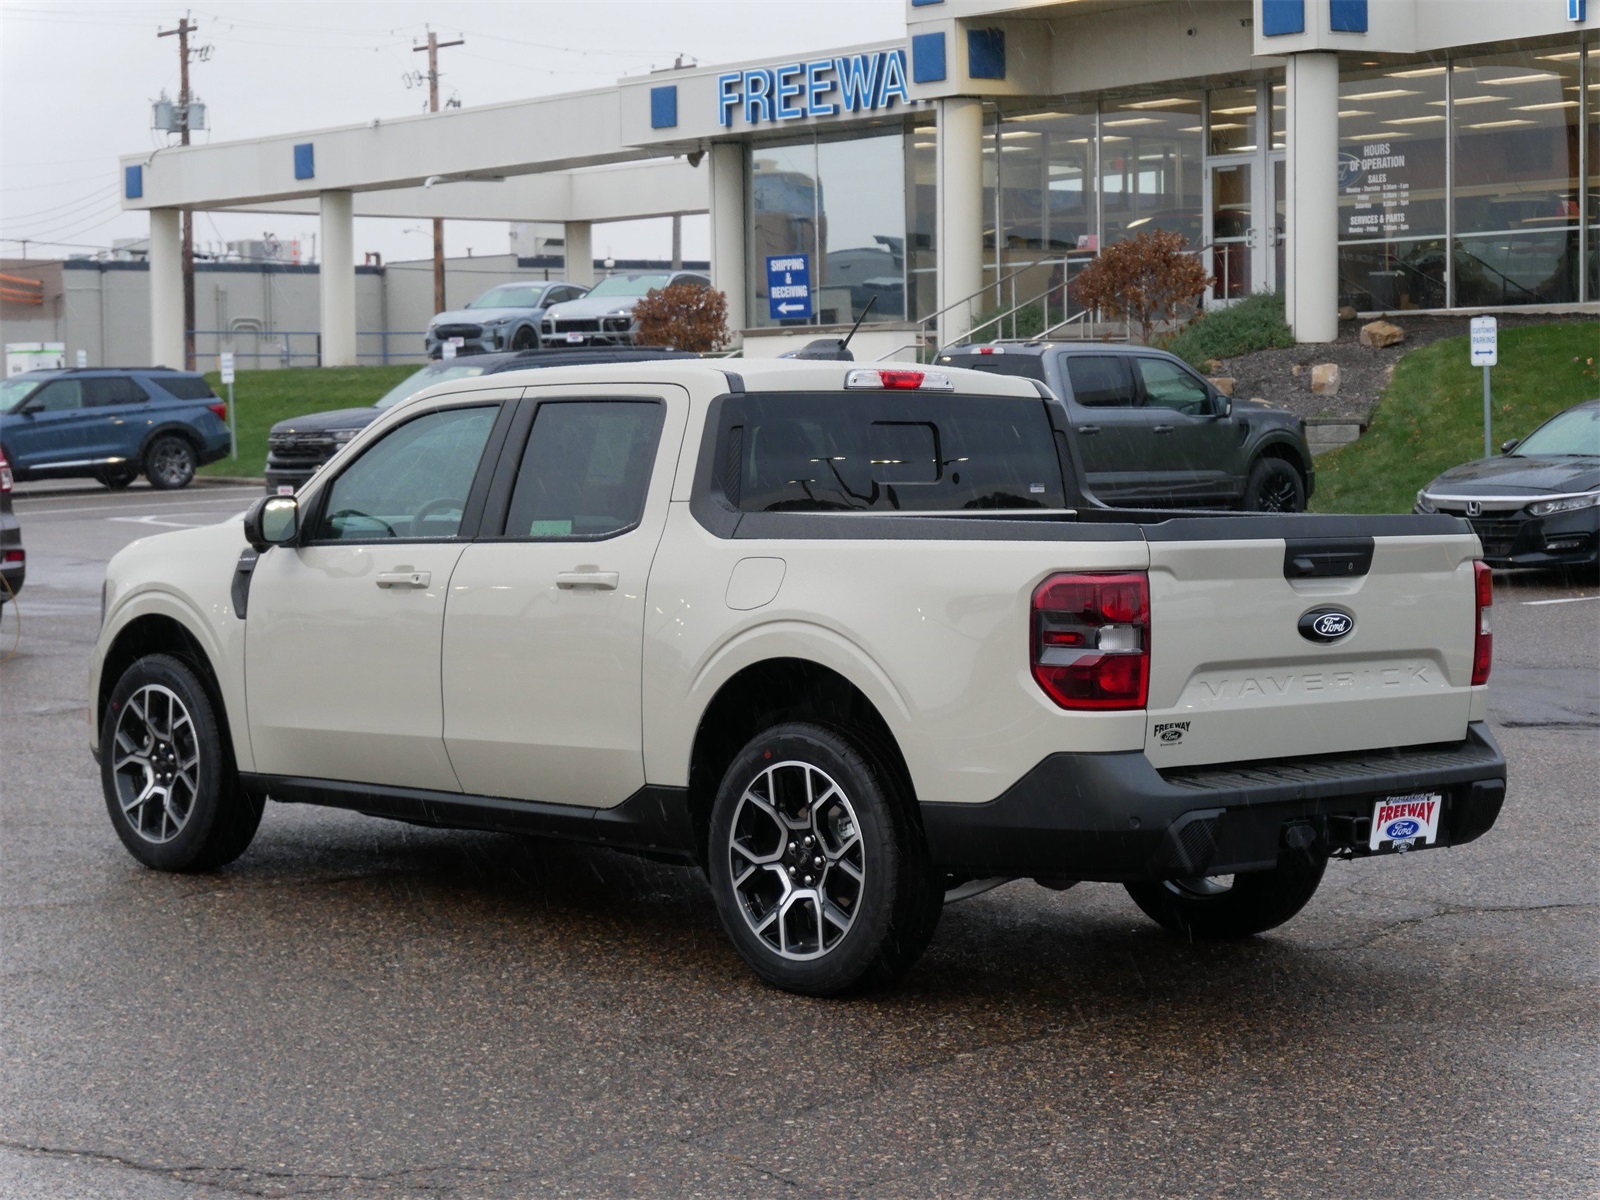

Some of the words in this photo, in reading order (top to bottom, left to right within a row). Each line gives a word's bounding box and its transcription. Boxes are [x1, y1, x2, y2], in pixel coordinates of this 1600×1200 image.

[718, 49, 909, 127] FREEWA
[1364, 143, 1390, 157] HOURS
[1350, 160, 1360, 171] OF
[1362, 155, 1405, 170] OPERATION
[1368, 174, 1387, 183] SALES
[1350, 215, 1378, 225] SERVICES
[1380, 215, 1384, 223] &
[1386, 213, 1405, 223] PARTS
[770, 258, 804, 272] SHIPPING
[785, 272, 792, 284] &
[771, 285, 807, 299] RECEIVING
[1472, 336, 1495, 344] PARKING
[1321, 616, 1346, 633] Ford
[1200, 666, 1429, 699] MAVERICK
[1153, 721, 1191, 738] FREEWAY
[1376, 801, 1435, 833] FREEWAY
[1391, 822, 1414, 836] Ford
